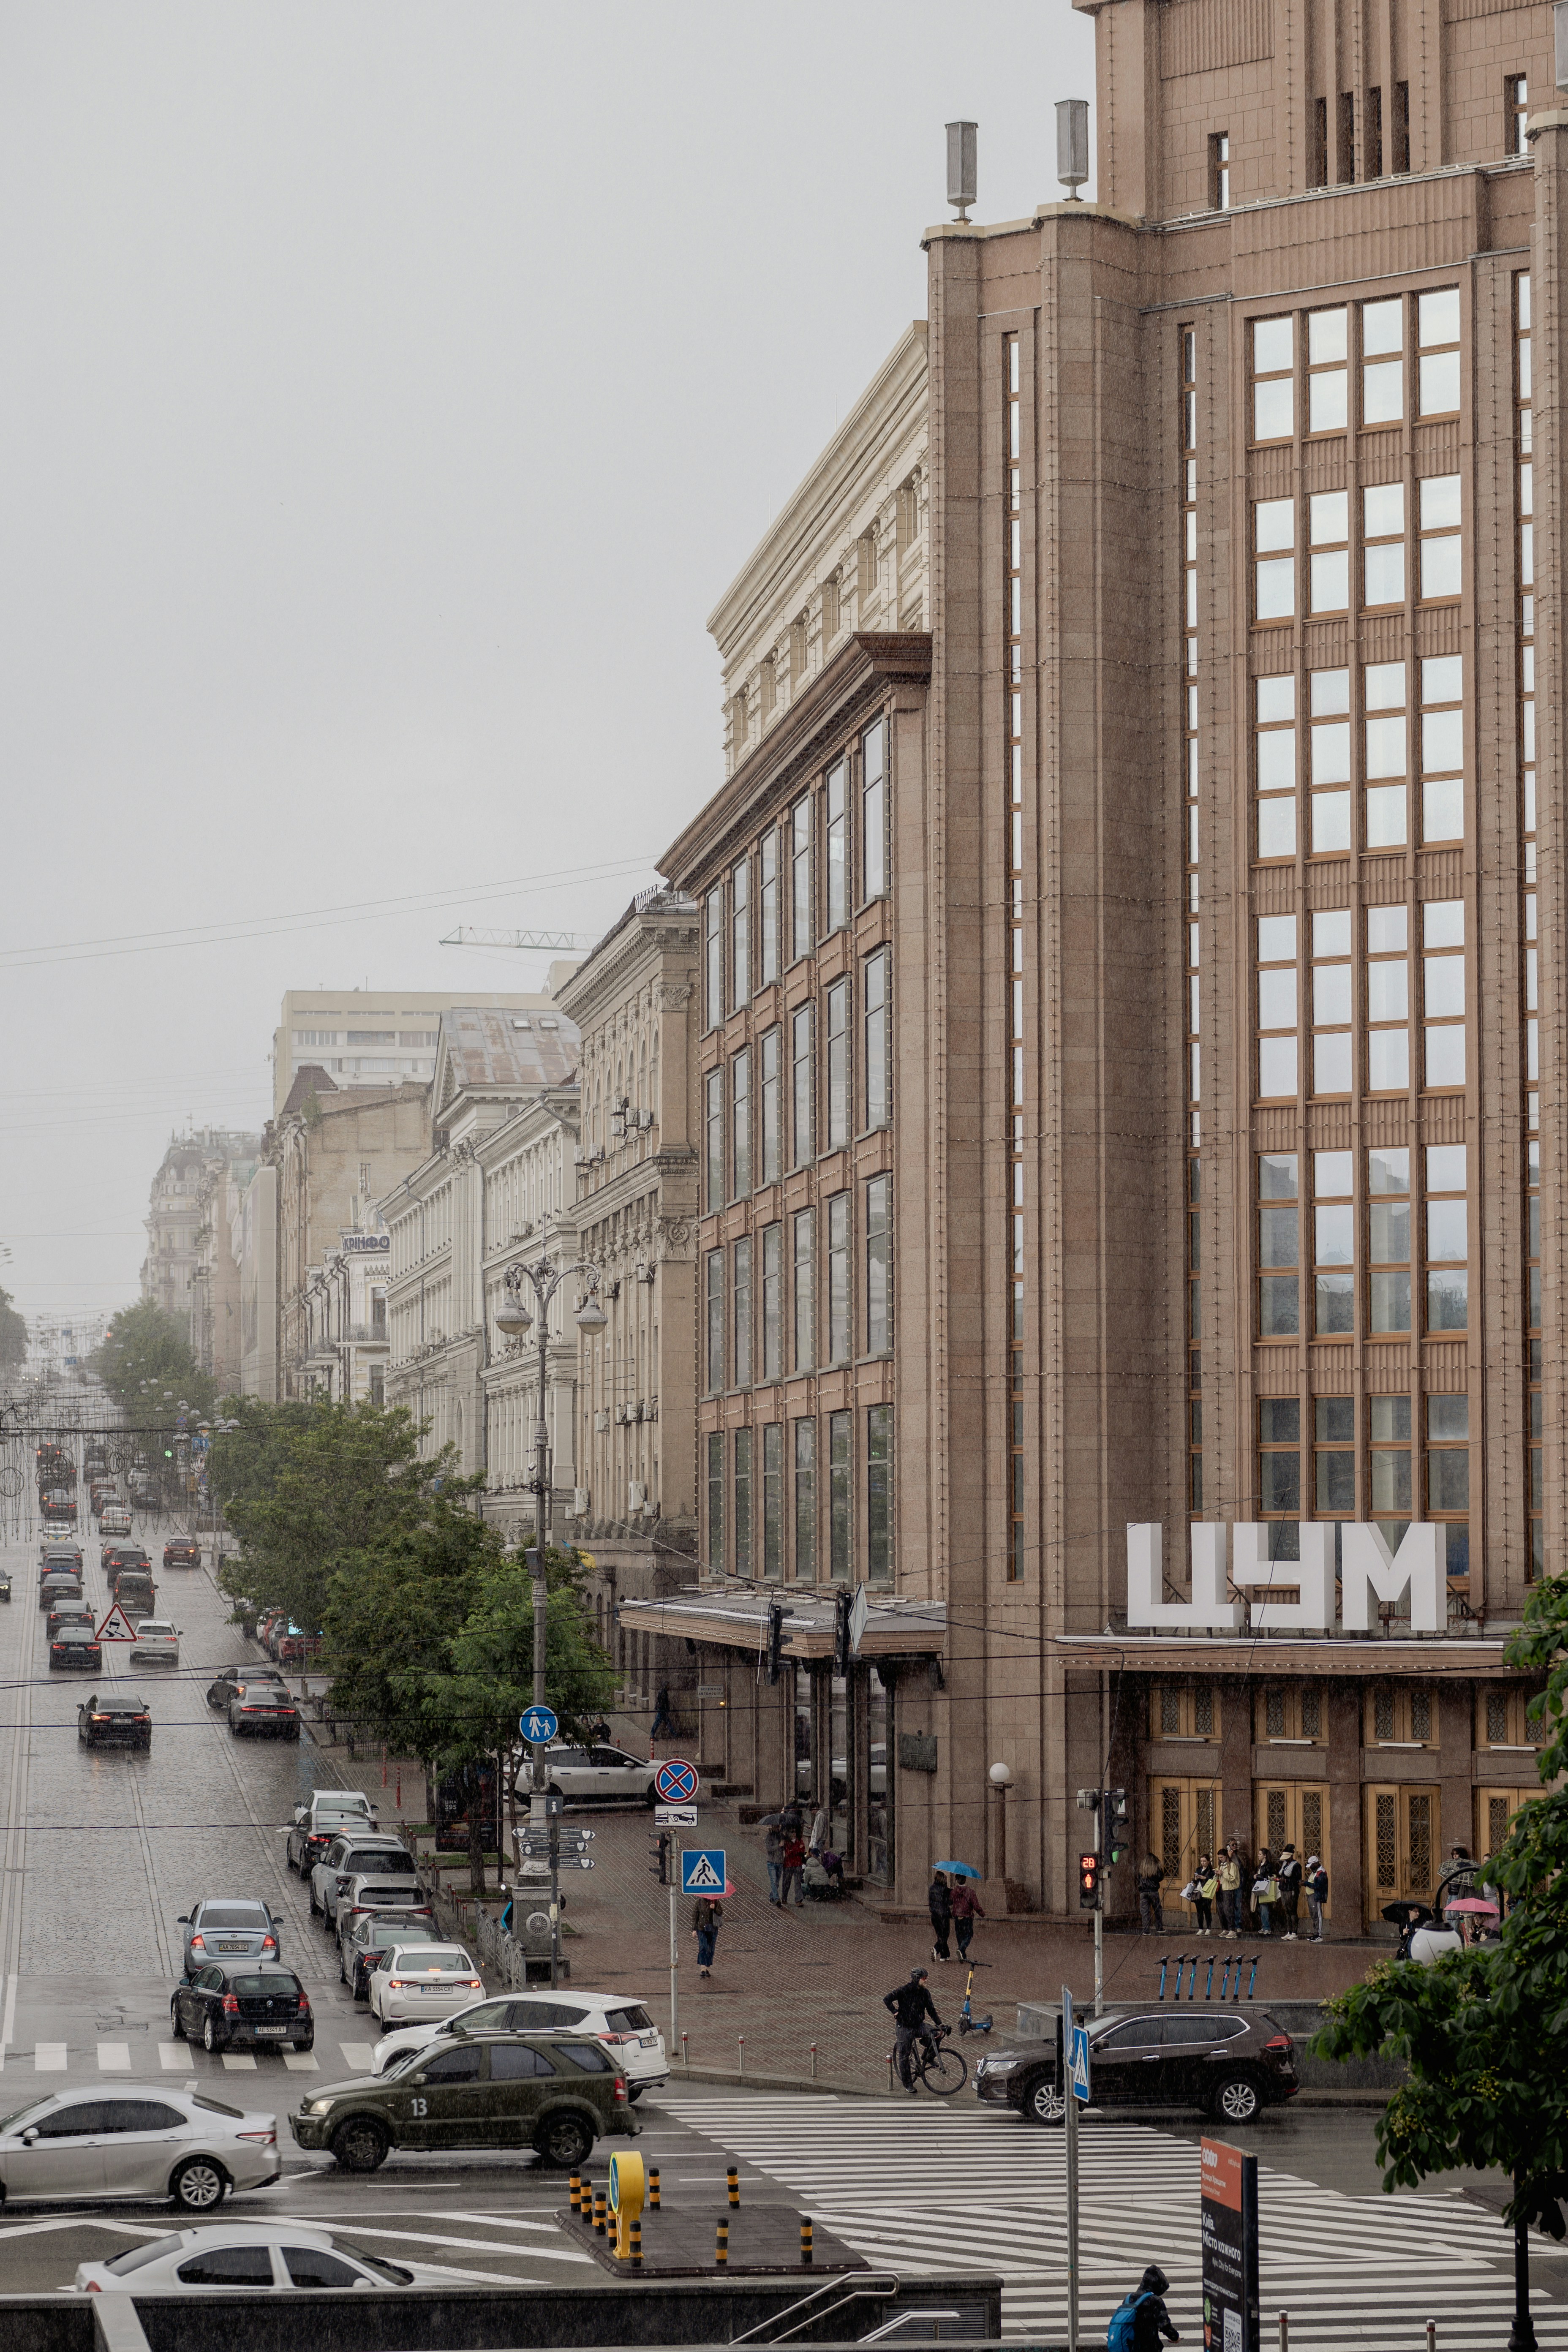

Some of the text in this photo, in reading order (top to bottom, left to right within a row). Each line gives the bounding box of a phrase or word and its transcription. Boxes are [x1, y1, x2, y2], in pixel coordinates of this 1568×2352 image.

[1127, 1522, 1447, 1631] ЦУМ
[1083, 1858, 1095, 1867] 28
[411, 2098, 427, 2116] 13
[1202, 2211, 1215, 2231] Київ.
[1203, 2230, 1241, 2262] Місто кожного
